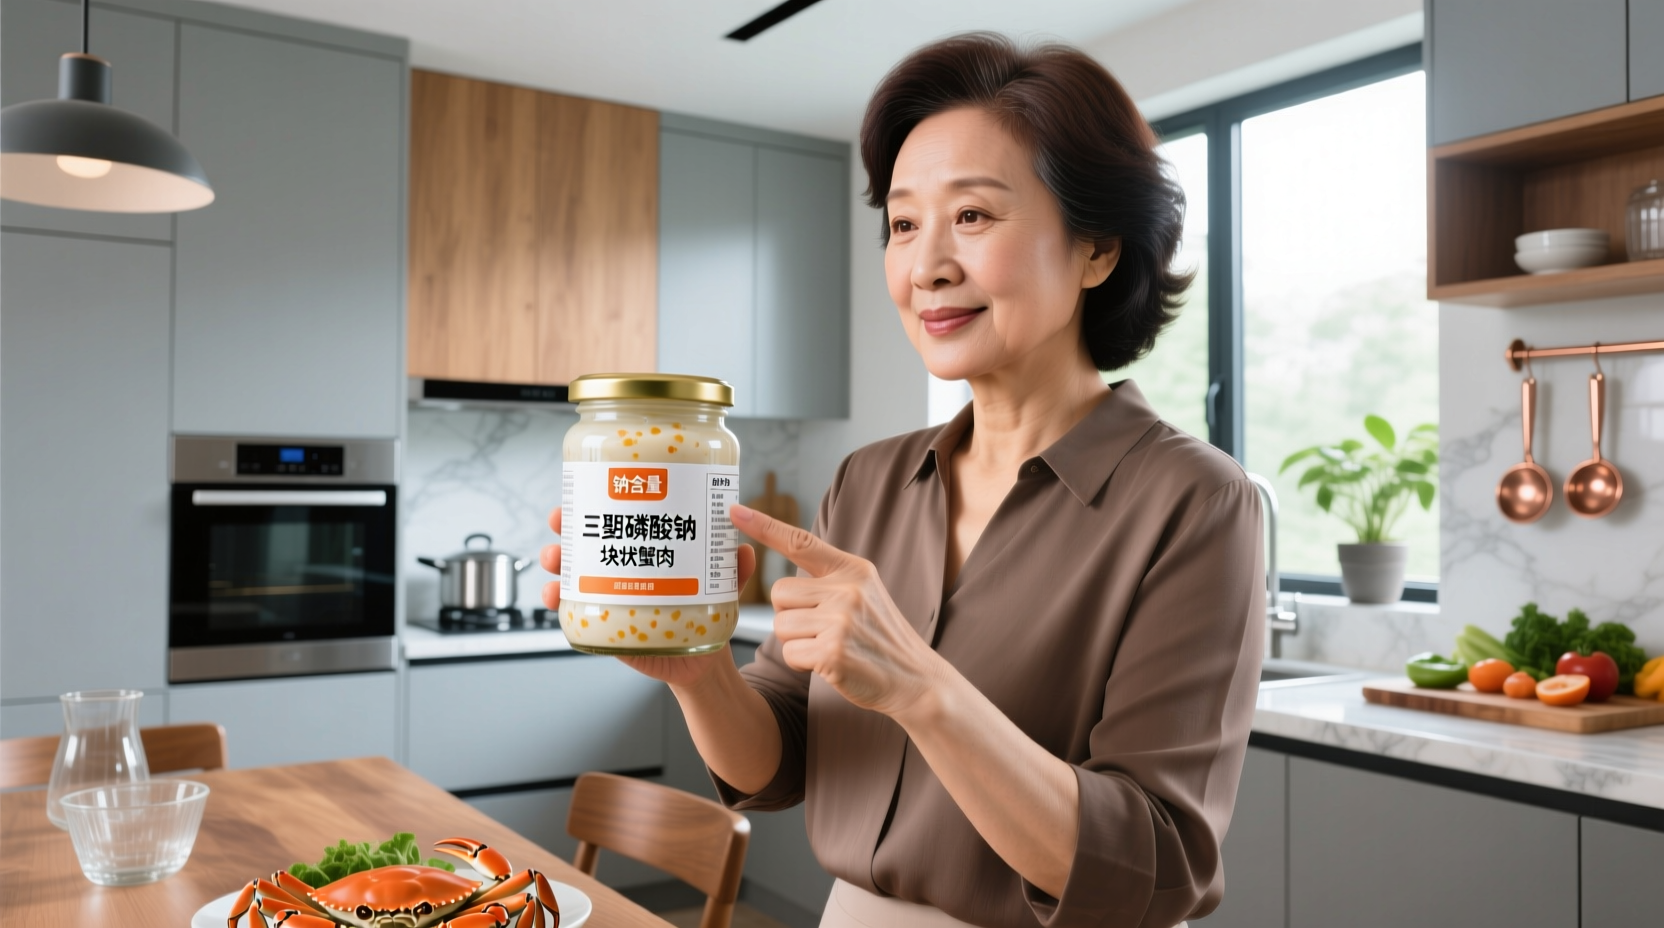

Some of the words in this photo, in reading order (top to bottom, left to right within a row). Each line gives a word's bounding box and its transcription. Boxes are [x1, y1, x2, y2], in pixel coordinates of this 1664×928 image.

[613, 474, 662, 494] 钠含量
[600, 544, 675, 568] 块状蟹肉
